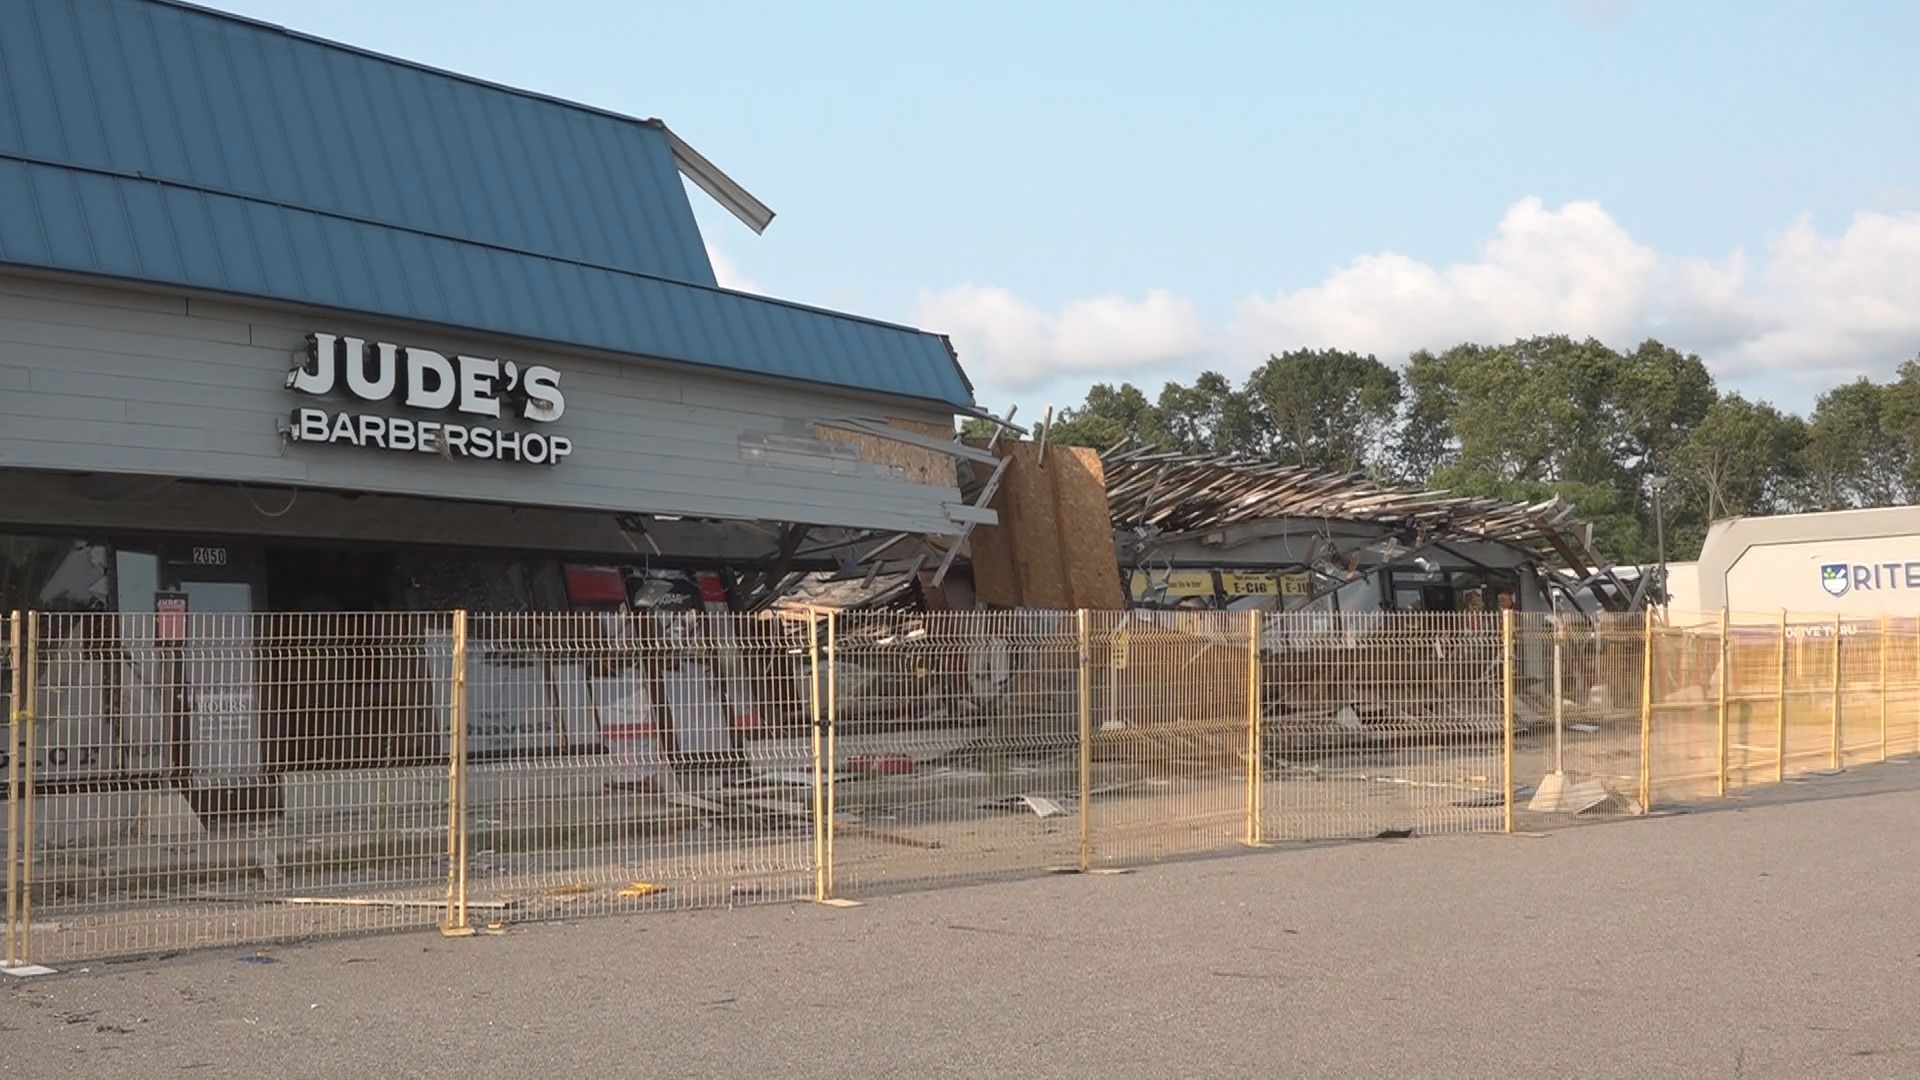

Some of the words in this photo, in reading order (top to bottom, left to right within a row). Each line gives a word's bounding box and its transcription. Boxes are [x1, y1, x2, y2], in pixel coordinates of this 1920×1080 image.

[293, 332, 565, 423] JUDE'S
[300, 407, 572, 464] BARBERSHOP
[194, 548, 226, 565] 2050
[1233, 582, 1267, 594] E-CIG
[1852, 562, 1920, 591] RITE
